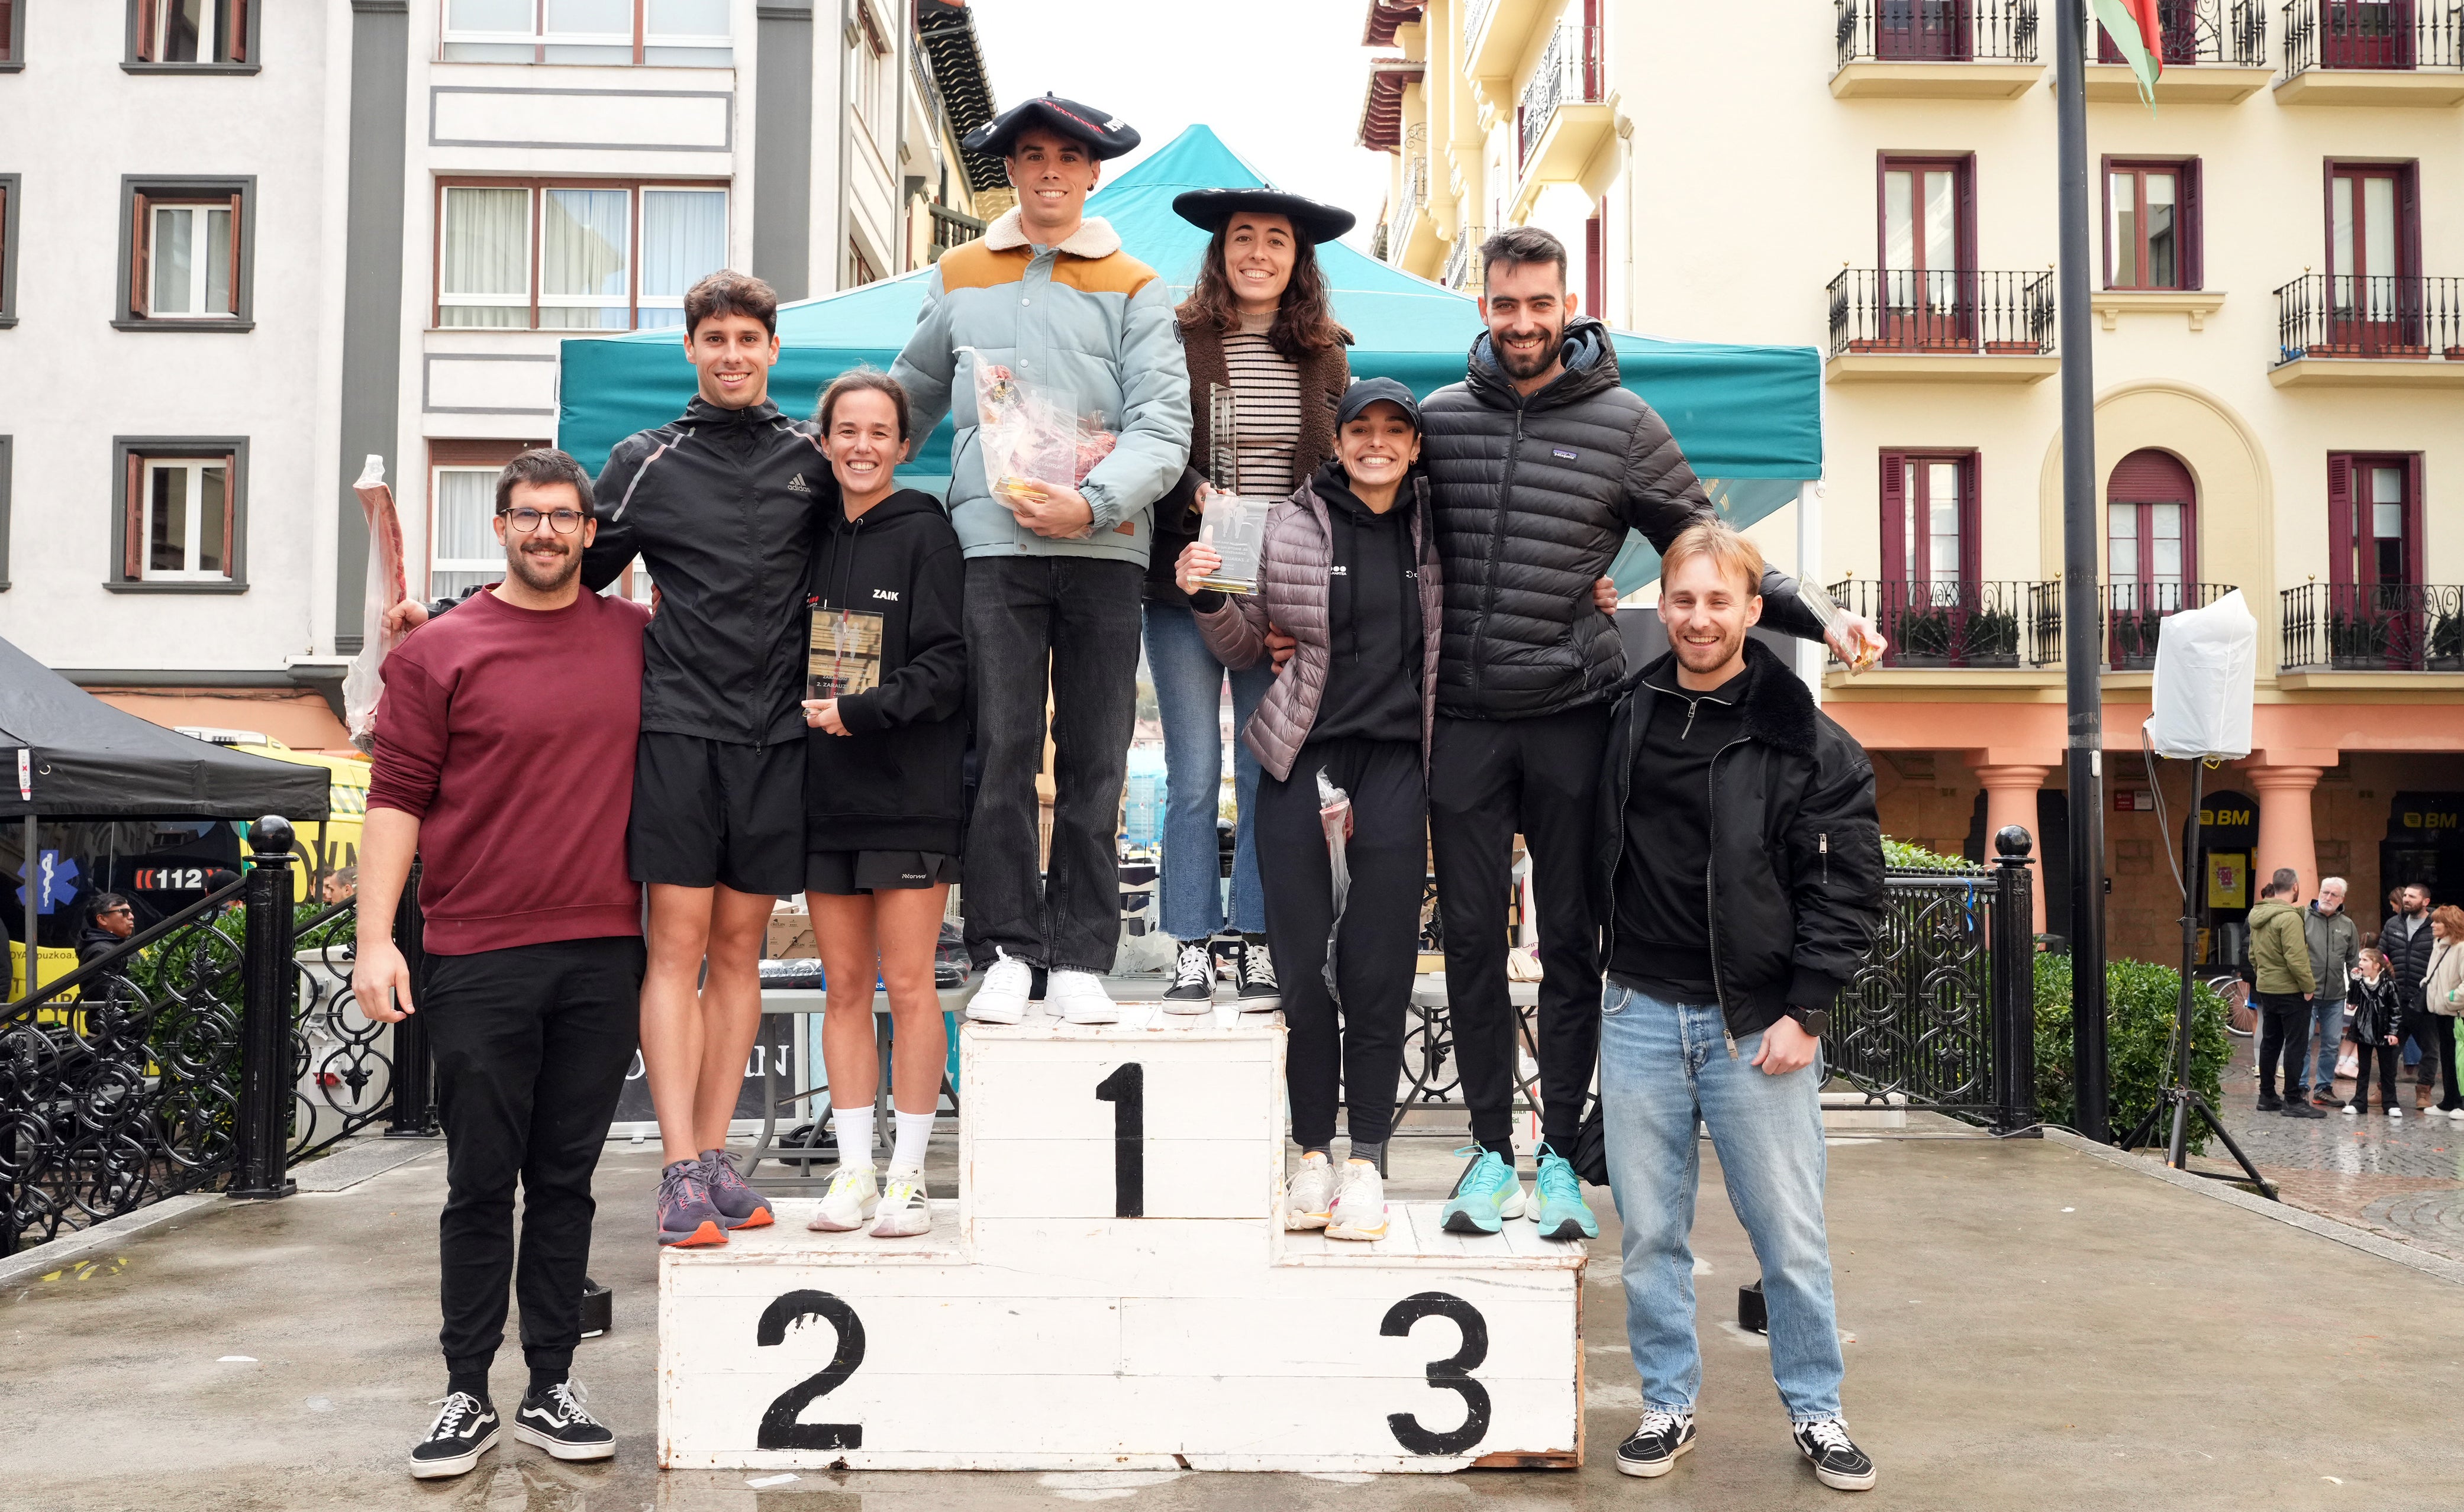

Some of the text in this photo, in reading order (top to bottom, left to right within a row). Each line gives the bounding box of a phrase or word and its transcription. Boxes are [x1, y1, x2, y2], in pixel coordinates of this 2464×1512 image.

[787, 484, 811, 493] adidas
[873, 589, 899, 601] ZAIK
[2217, 809, 2250, 825] BM
[2424, 812, 2457, 828] BM
[156, 869, 202, 889] 112
[1095, 1062, 1146, 1219] 1
[757, 1289, 866, 1452] 2
[1379, 1291, 1491, 1456] 3
